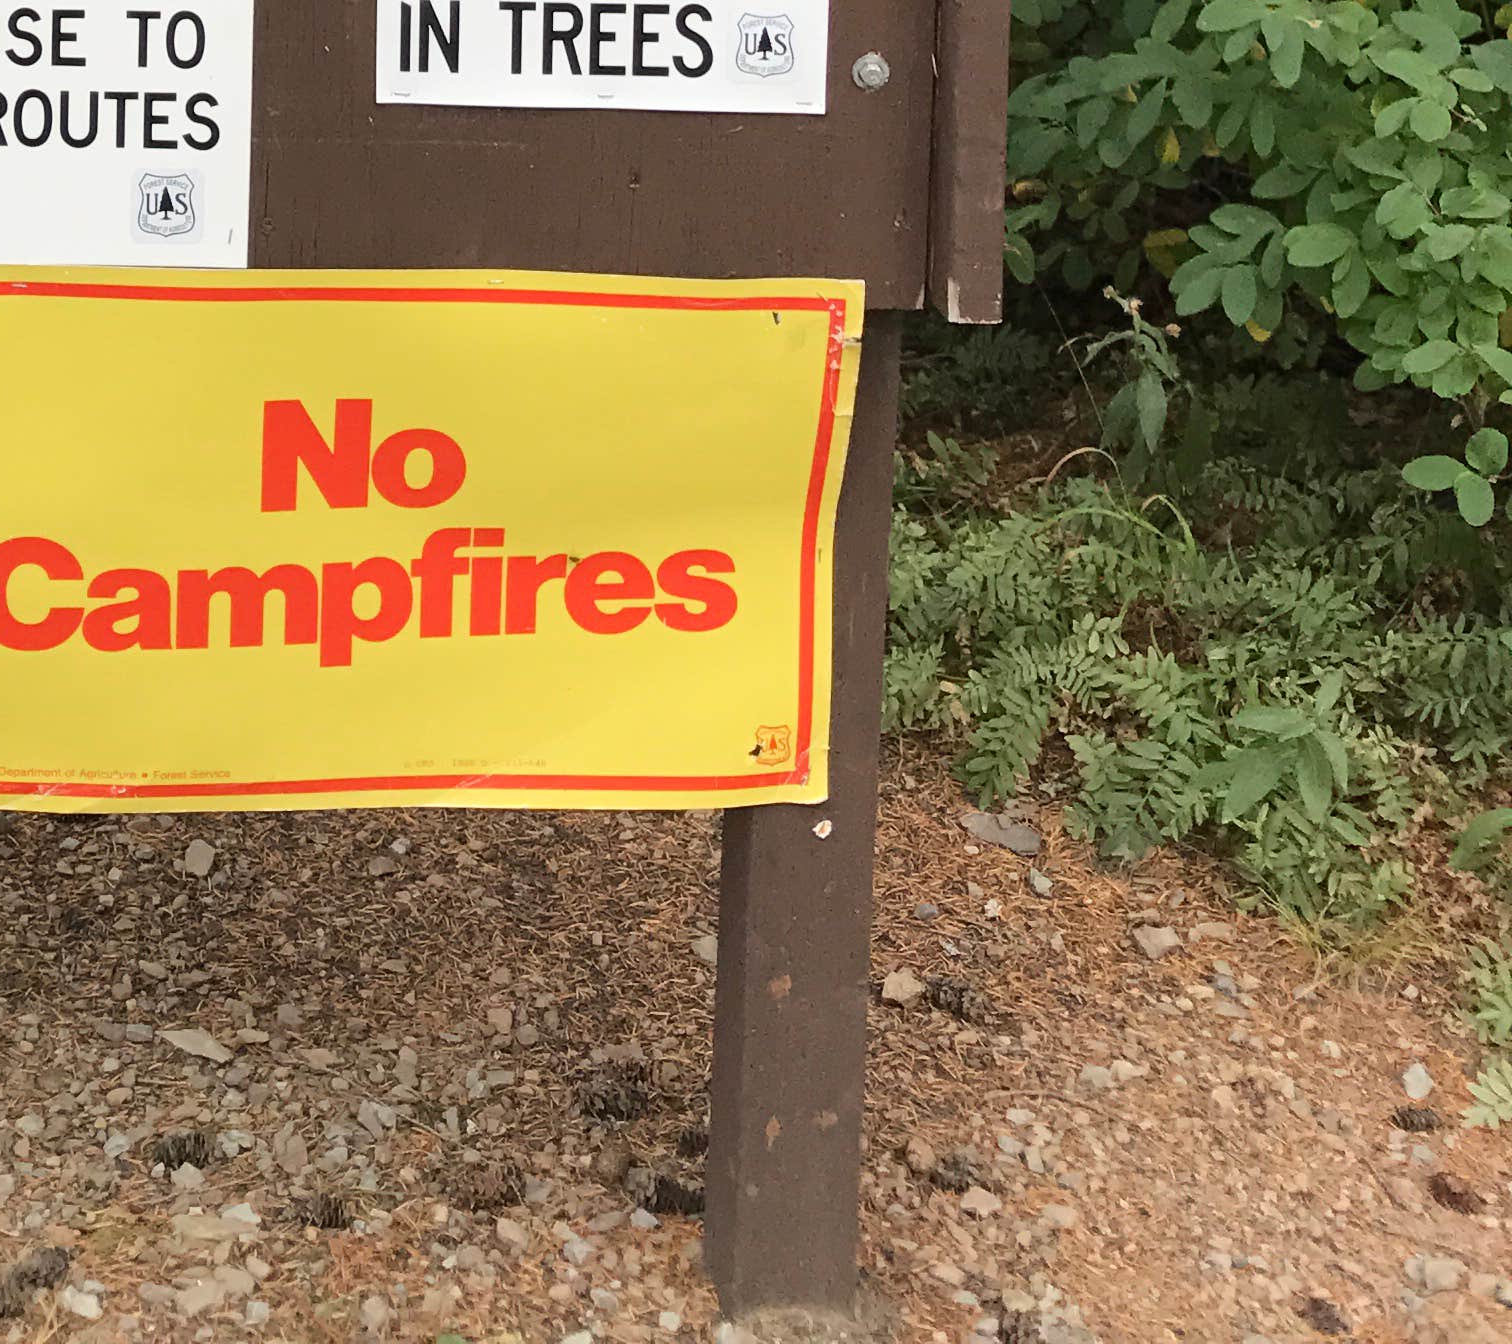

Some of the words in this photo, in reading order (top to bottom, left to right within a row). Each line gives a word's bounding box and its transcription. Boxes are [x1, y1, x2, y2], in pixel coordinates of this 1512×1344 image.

[127, 11, 205, 69] TO
[400, 0, 460, 73] IN
[499, 2, 713, 77] TREES
[261, 399, 466, 512] No
